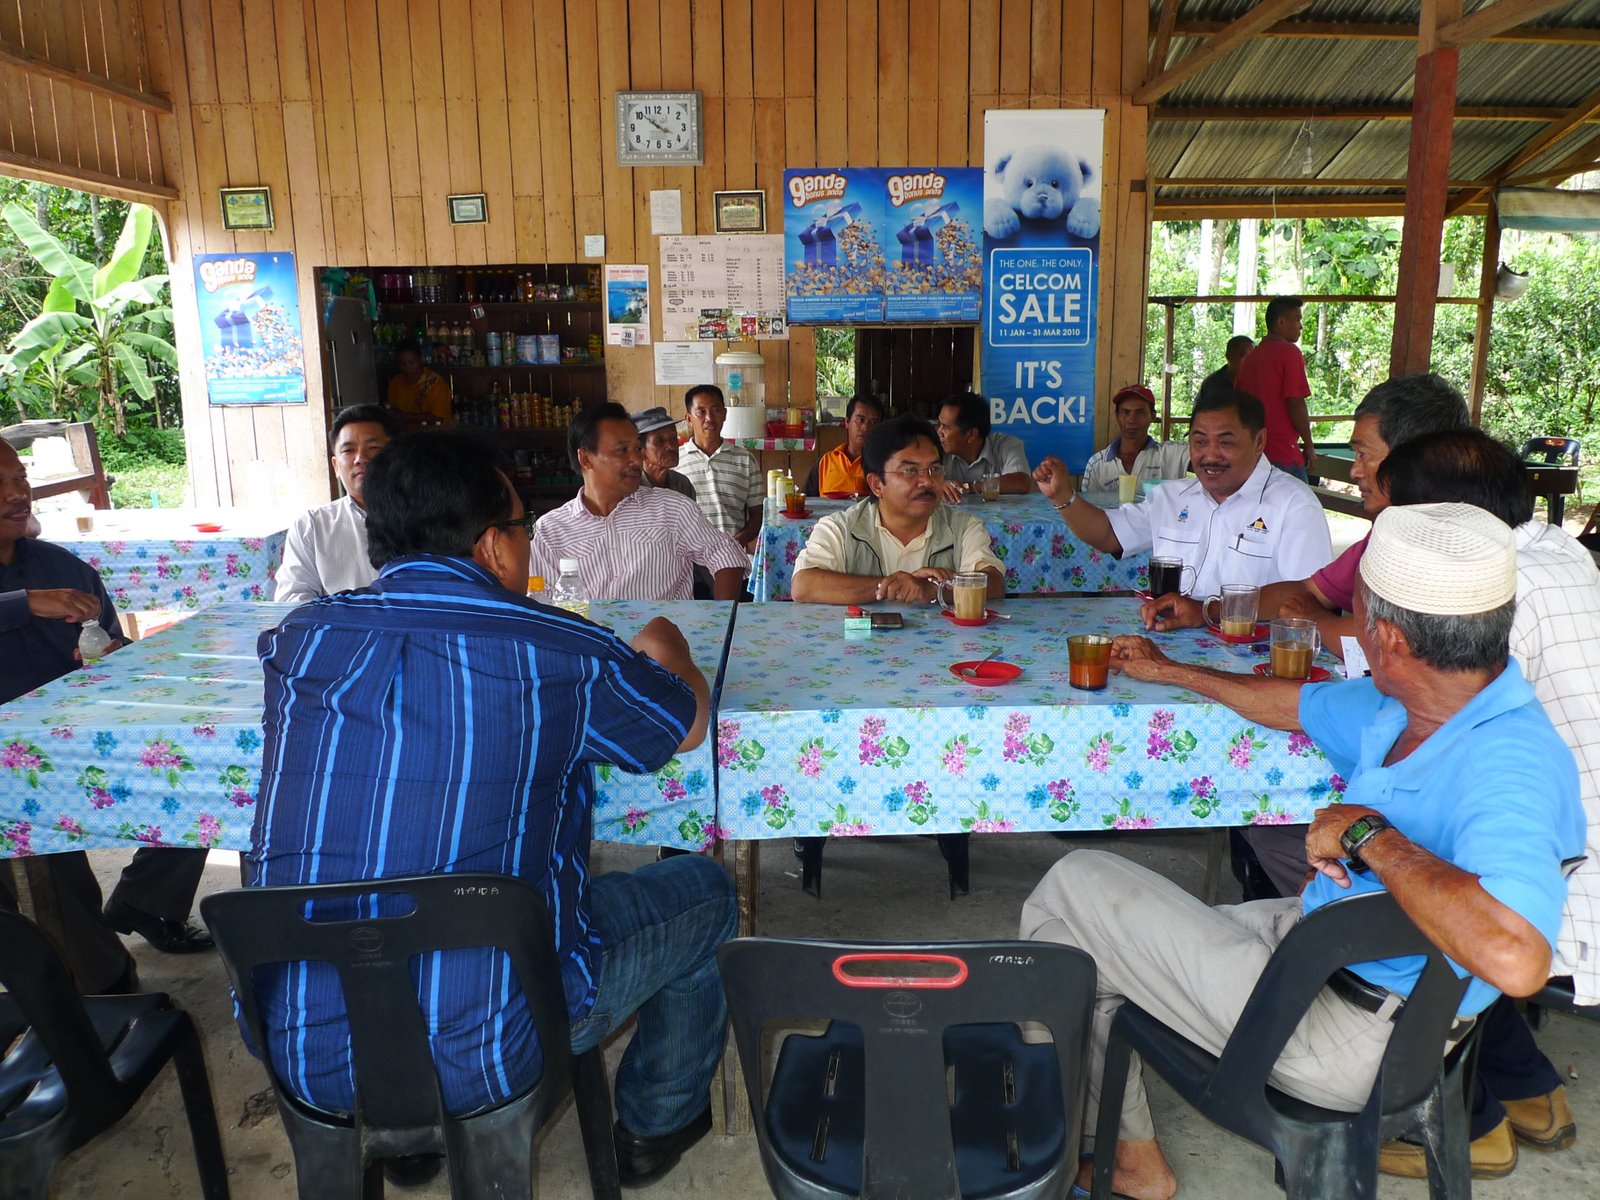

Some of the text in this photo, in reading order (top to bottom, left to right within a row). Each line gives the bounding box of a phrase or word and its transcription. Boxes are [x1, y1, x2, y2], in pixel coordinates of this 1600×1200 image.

[644, 105, 651, 115] 11
[653, 105, 662, 115] 12
[666, 105, 670, 115] 1
[635, 111, 644, 121] 10
[675, 111, 681, 120] 2
[630, 123, 636, 132] 9
[681, 123, 687, 132] 3
[635, 134, 641, 143] 8
[676, 133, 681, 143] 4
[646, 139, 651, 148] 7
[656, 139, 662, 149] 6
[666, 139, 672, 149] 5
[788, 173, 846, 207] ganda
[887, 172, 945, 206] ganda
[1000, 259, 1084, 268] THE ONE. THE ONLY.
[1000, 273, 1082, 291] CELCOM
[998, 293, 1081, 324] SALE
[1000, 329, 1007, 337] 11
[1010, 329, 1025, 337] JAN
[1033, 328, 1041, 337] 31
[1043, 328, 1061, 337] MAR
[1062, 328, 1080, 336] 2010
[1015, 361, 1063, 389] IT'S
[989, 396, 1086, 425] BACK!
